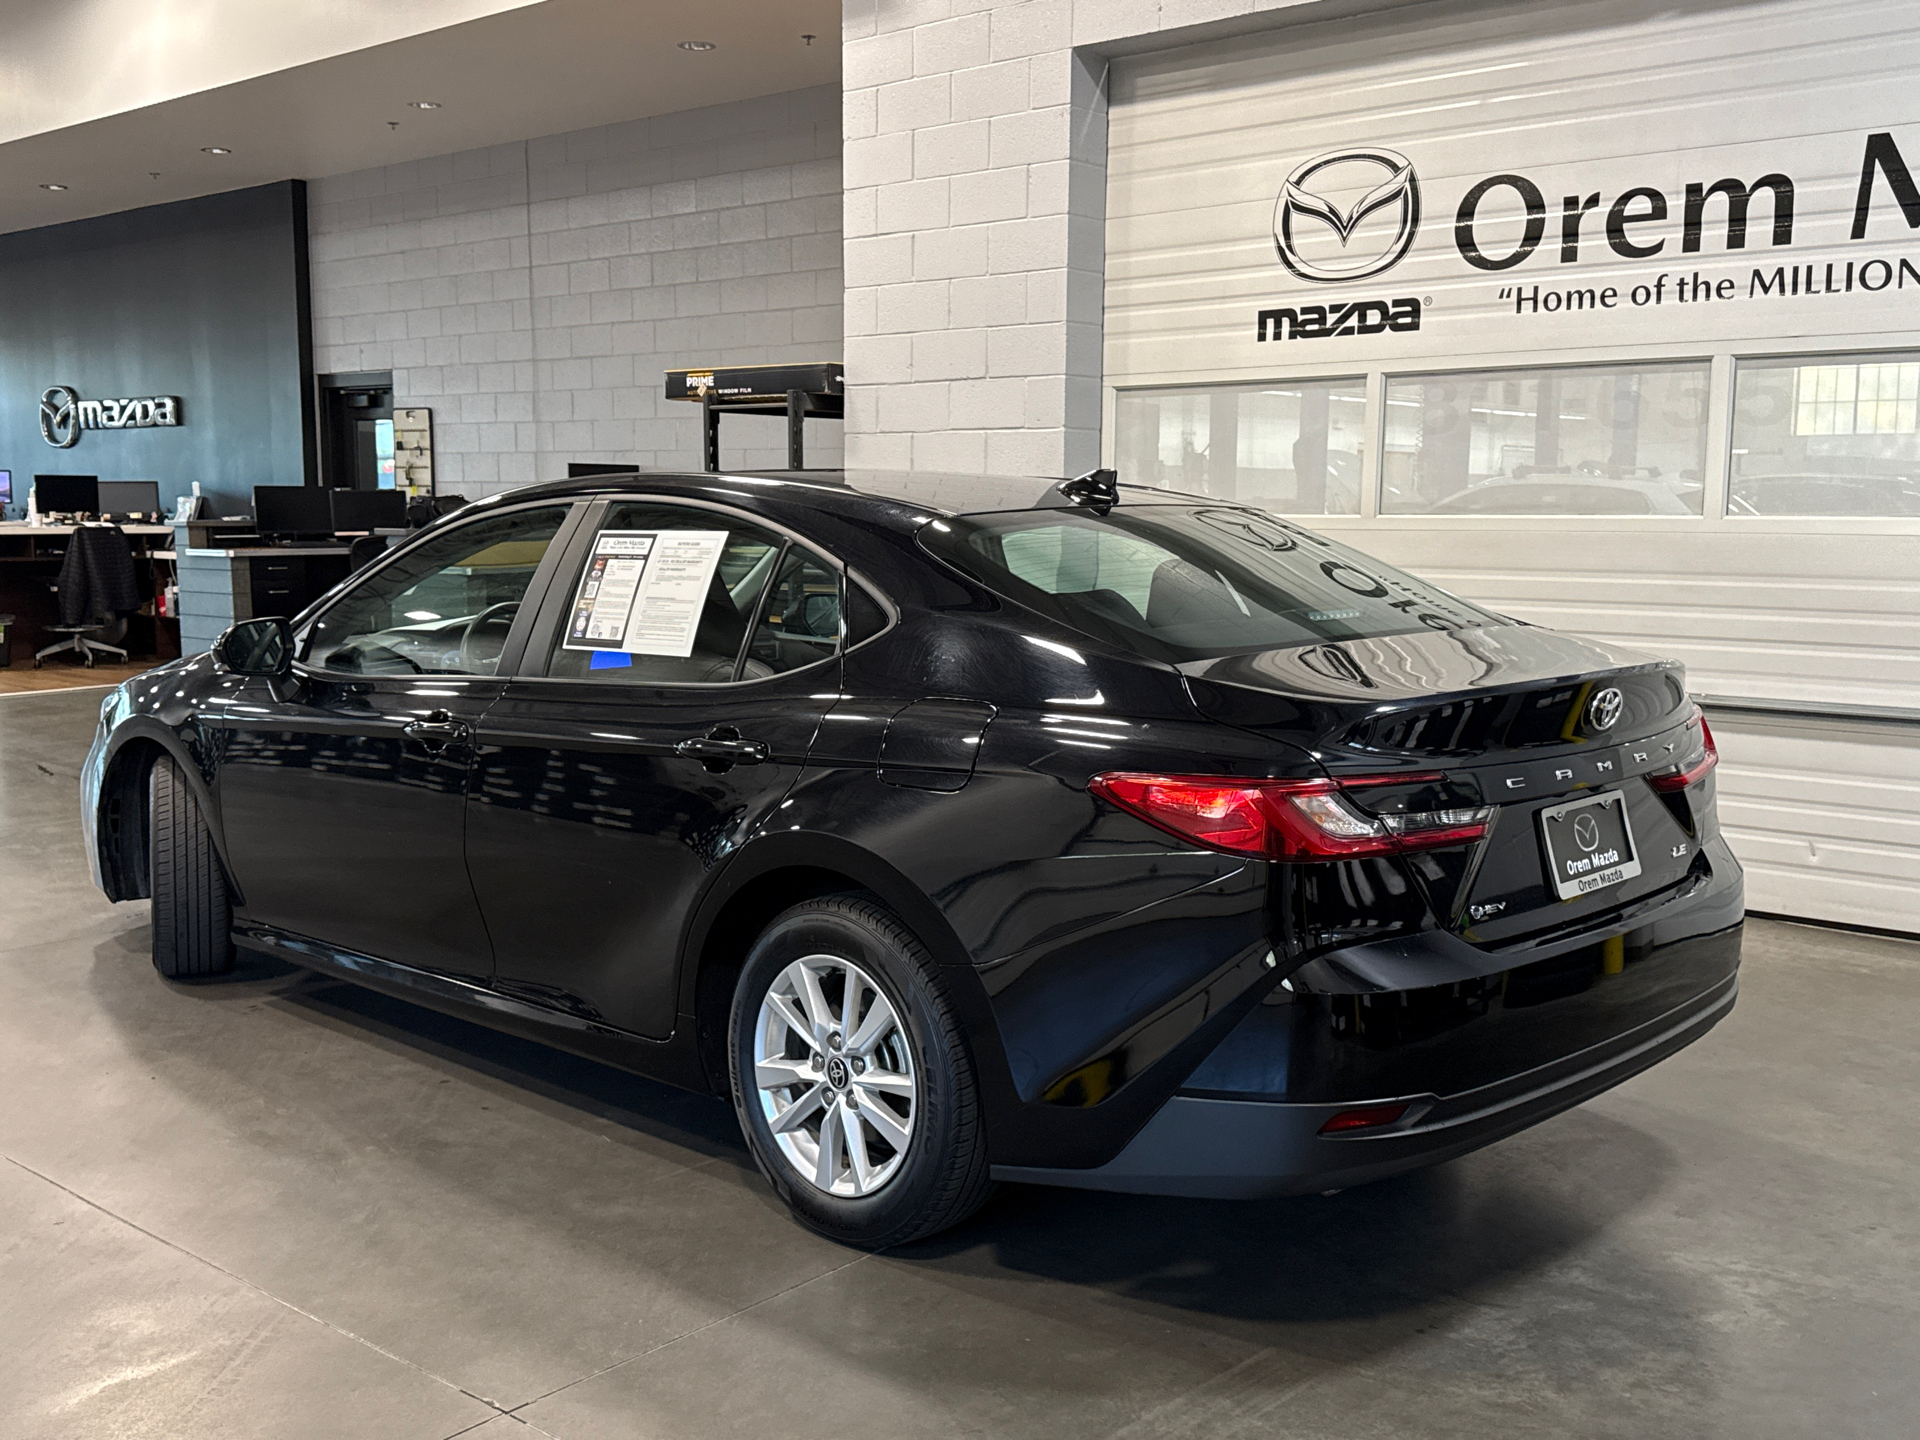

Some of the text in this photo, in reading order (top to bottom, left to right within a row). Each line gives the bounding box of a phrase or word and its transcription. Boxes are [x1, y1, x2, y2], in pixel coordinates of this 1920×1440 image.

[1454, 173, 1795, 271] Orem
[1631, 273, 1668, 306] of
[1676, 271, 1735, 303] the
[1257, 297, 1421, 342] mazda
[686, 375, 715, 387] PRIME
[77, 396, 178, 429] mazda
[1506, 743, 1674, 789] CAMRY
[1566, 848, 1619, 876] Orem Mazda
[1671, 843, 1687, 858] LE
[1578, 868, 1624, 892] Orem Mazda
[1480, 901, 1506, 915] HEV
